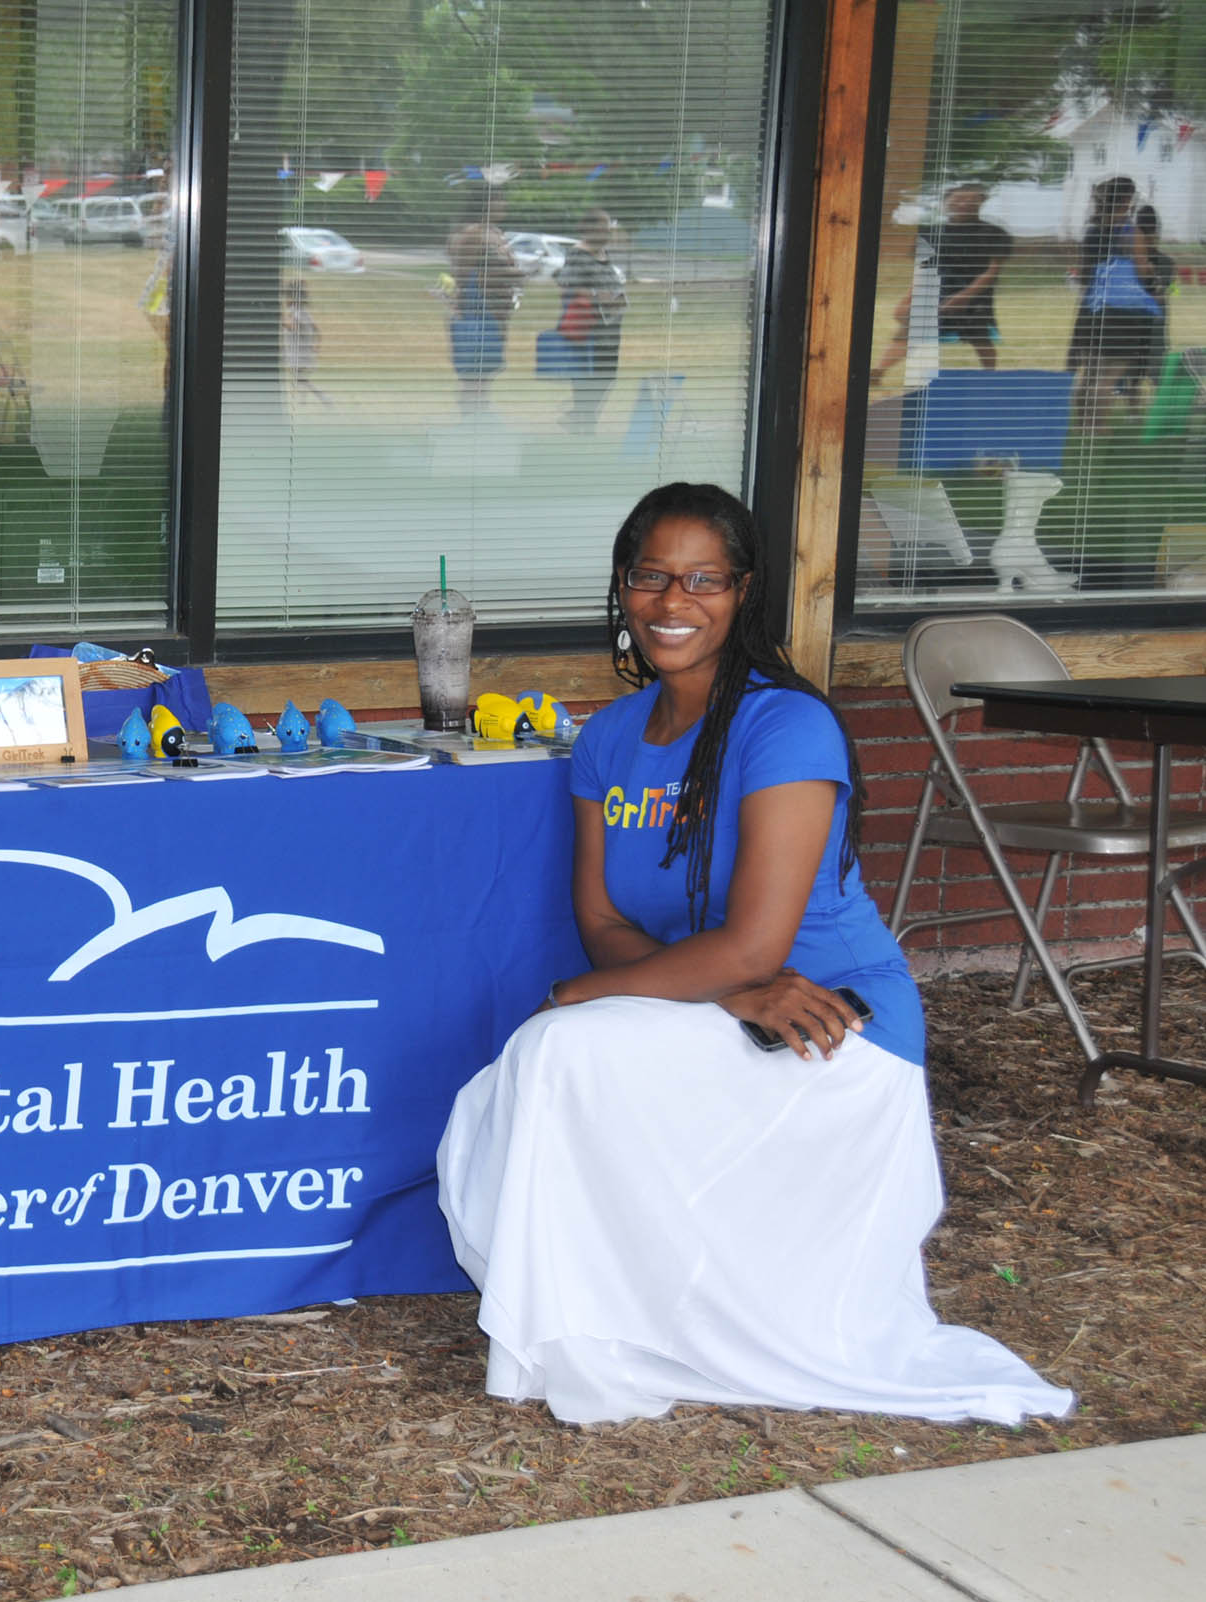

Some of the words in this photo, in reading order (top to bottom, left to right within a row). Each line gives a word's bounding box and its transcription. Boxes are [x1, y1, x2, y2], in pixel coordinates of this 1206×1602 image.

[2, 747, 45, 761] GirlTrek
[107, 1047, 371, 1129] Health
[51, 1172, 106, 1227] of
[103, 1162, 364, 1226] Denver
